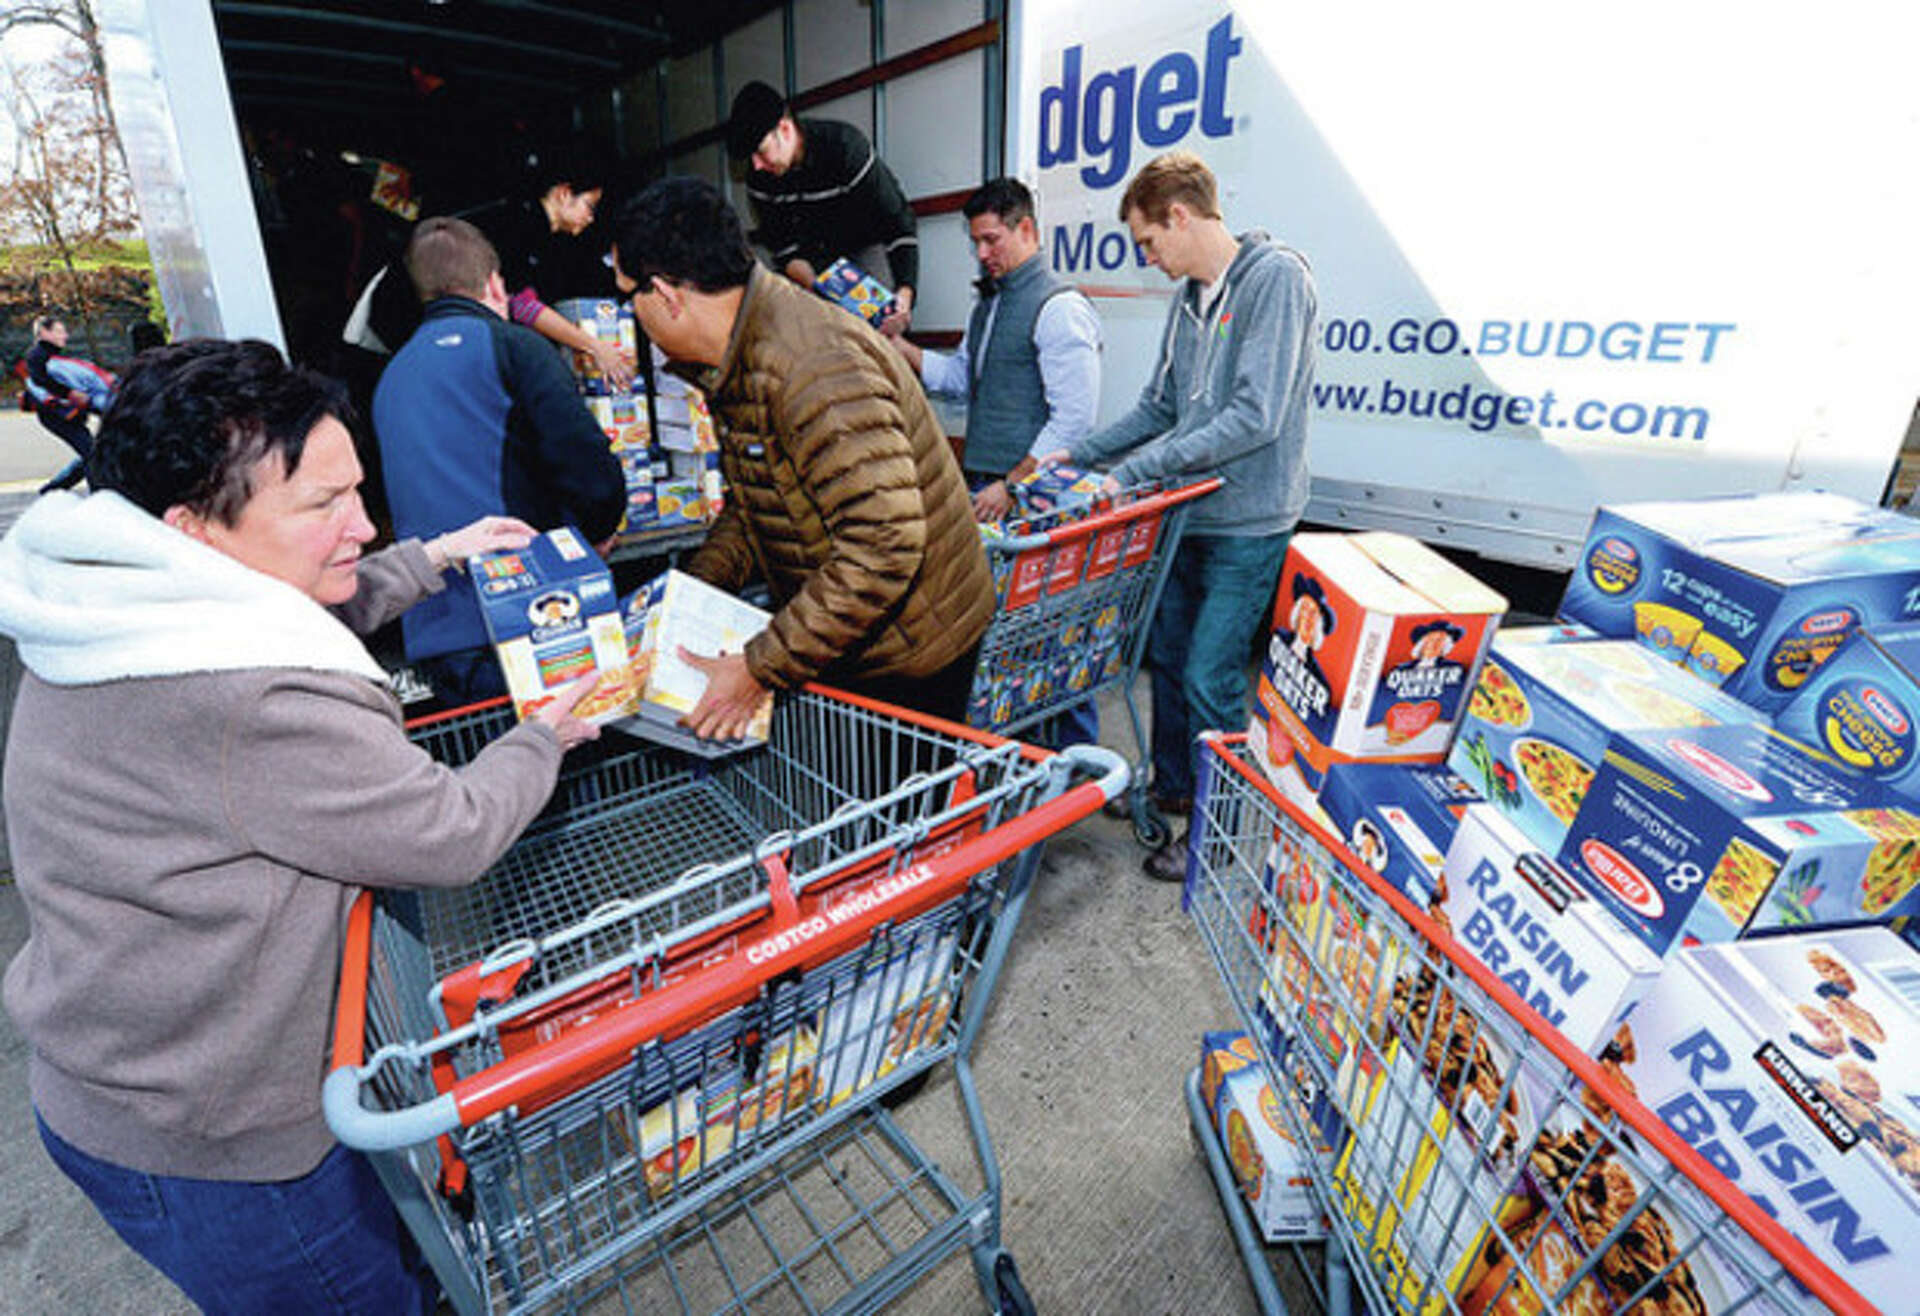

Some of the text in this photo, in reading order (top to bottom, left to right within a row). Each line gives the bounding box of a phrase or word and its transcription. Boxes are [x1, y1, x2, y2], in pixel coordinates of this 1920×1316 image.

[1038, 13, 1242, 189] dget
[1318, 318, 1737, 363] 00.GO.BUDGET
[1661, 568, 1687, 595] 12
[1702, 600, 1758, 638] easy
[1269, 634, 1330, 717] QUAKER
[1272, 666, 1310, 720] OATS
[1386, 666, 1464, 690] QUAKER
[1398, 681, 1443, 697] OATS
[1612, 792, 1690, 857] LINGUINE
[1665, 862, 1704, 893] 8
[746, 865, 936, 965] COSTCO WHOLESALE
[1466, 857, 1590, 997] RAISIN
[1761, 1046, 1857, 1143] KIRKLAND
[1669, 1027, 1891, 1265] RAISIN
